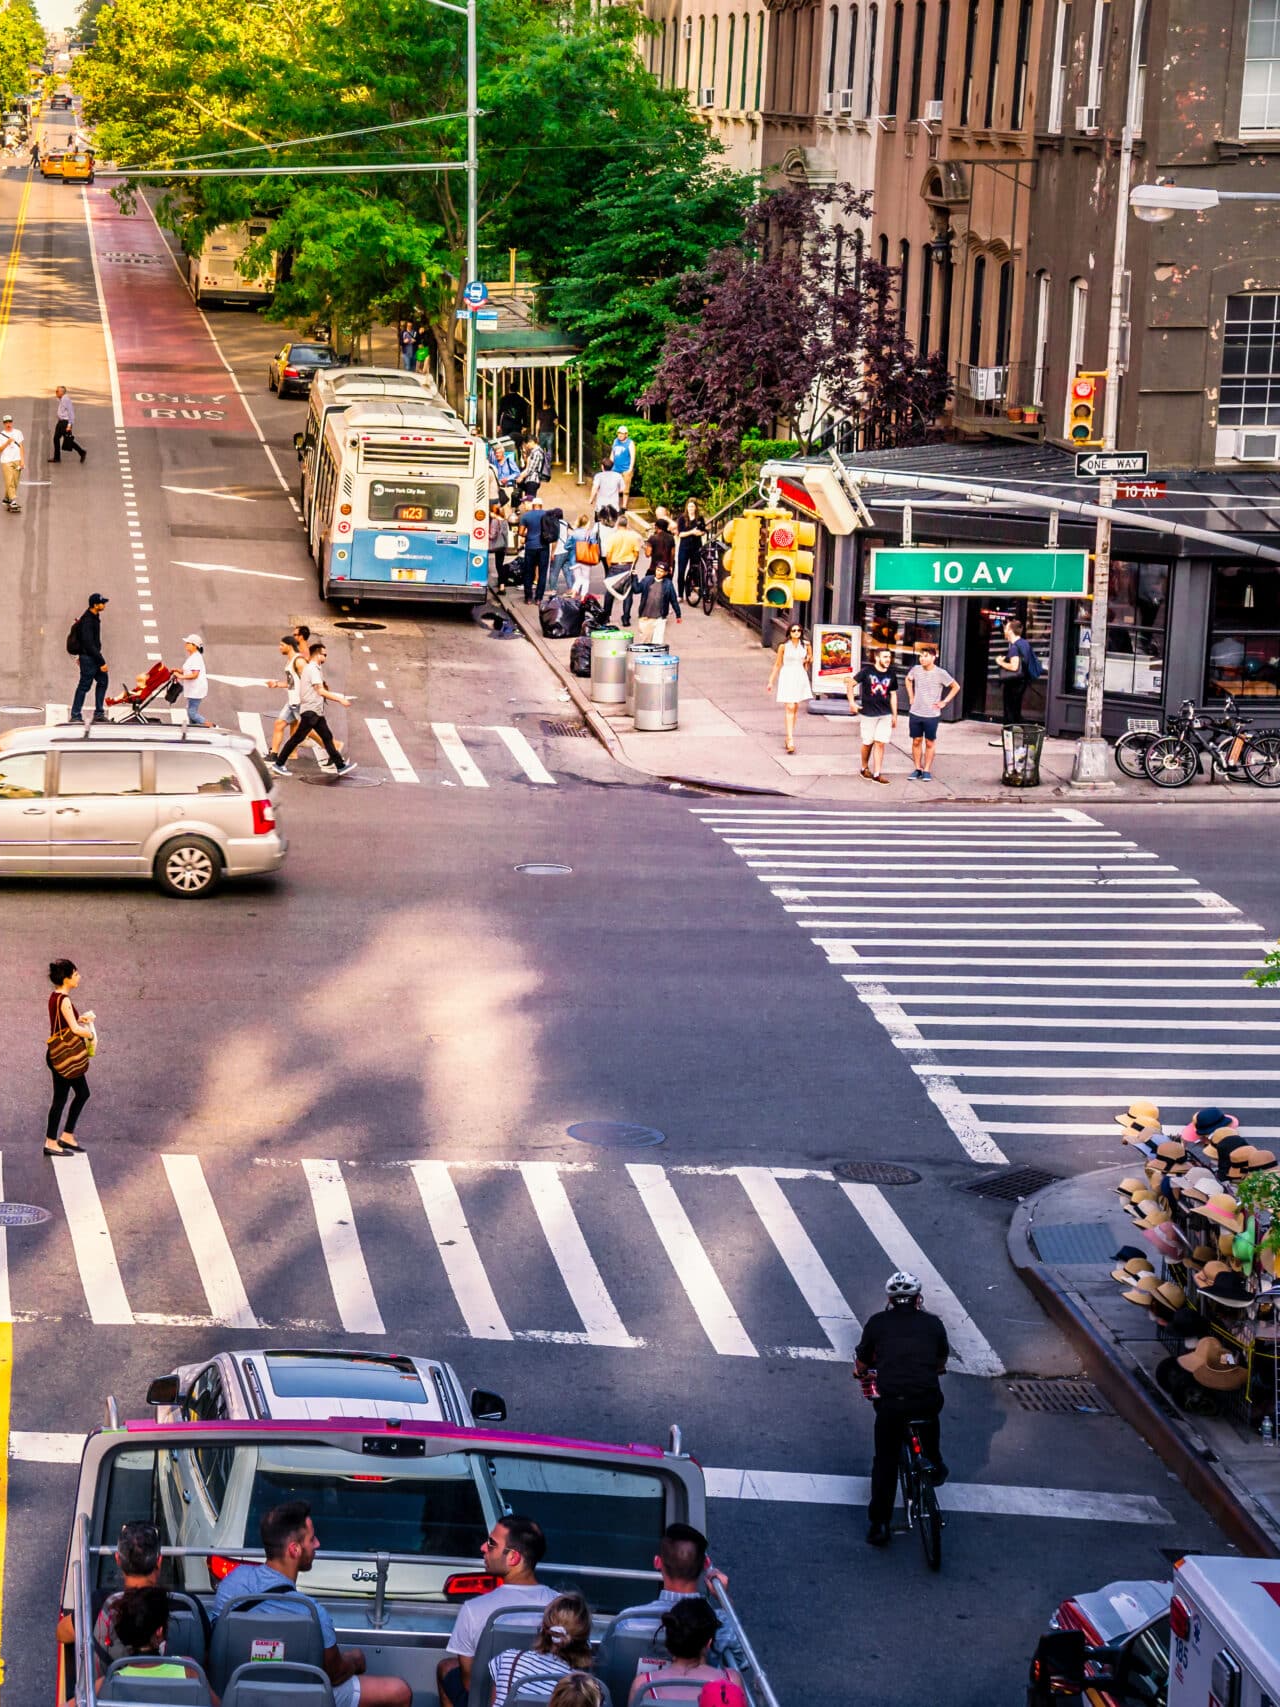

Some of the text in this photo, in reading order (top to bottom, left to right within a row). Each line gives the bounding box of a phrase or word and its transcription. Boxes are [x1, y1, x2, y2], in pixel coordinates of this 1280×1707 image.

[150, 408, 225, 421] BUS
[1087, 459, 1138, 470] ONE WAY
[1125, 485, 1138, 498] 10
[402, 507, 422, 519] M23
[932, 561, 1014, 584] 10 Av
[1082, 631, 1092, 643] A
[352, 1568, 381, 1582] Jee
